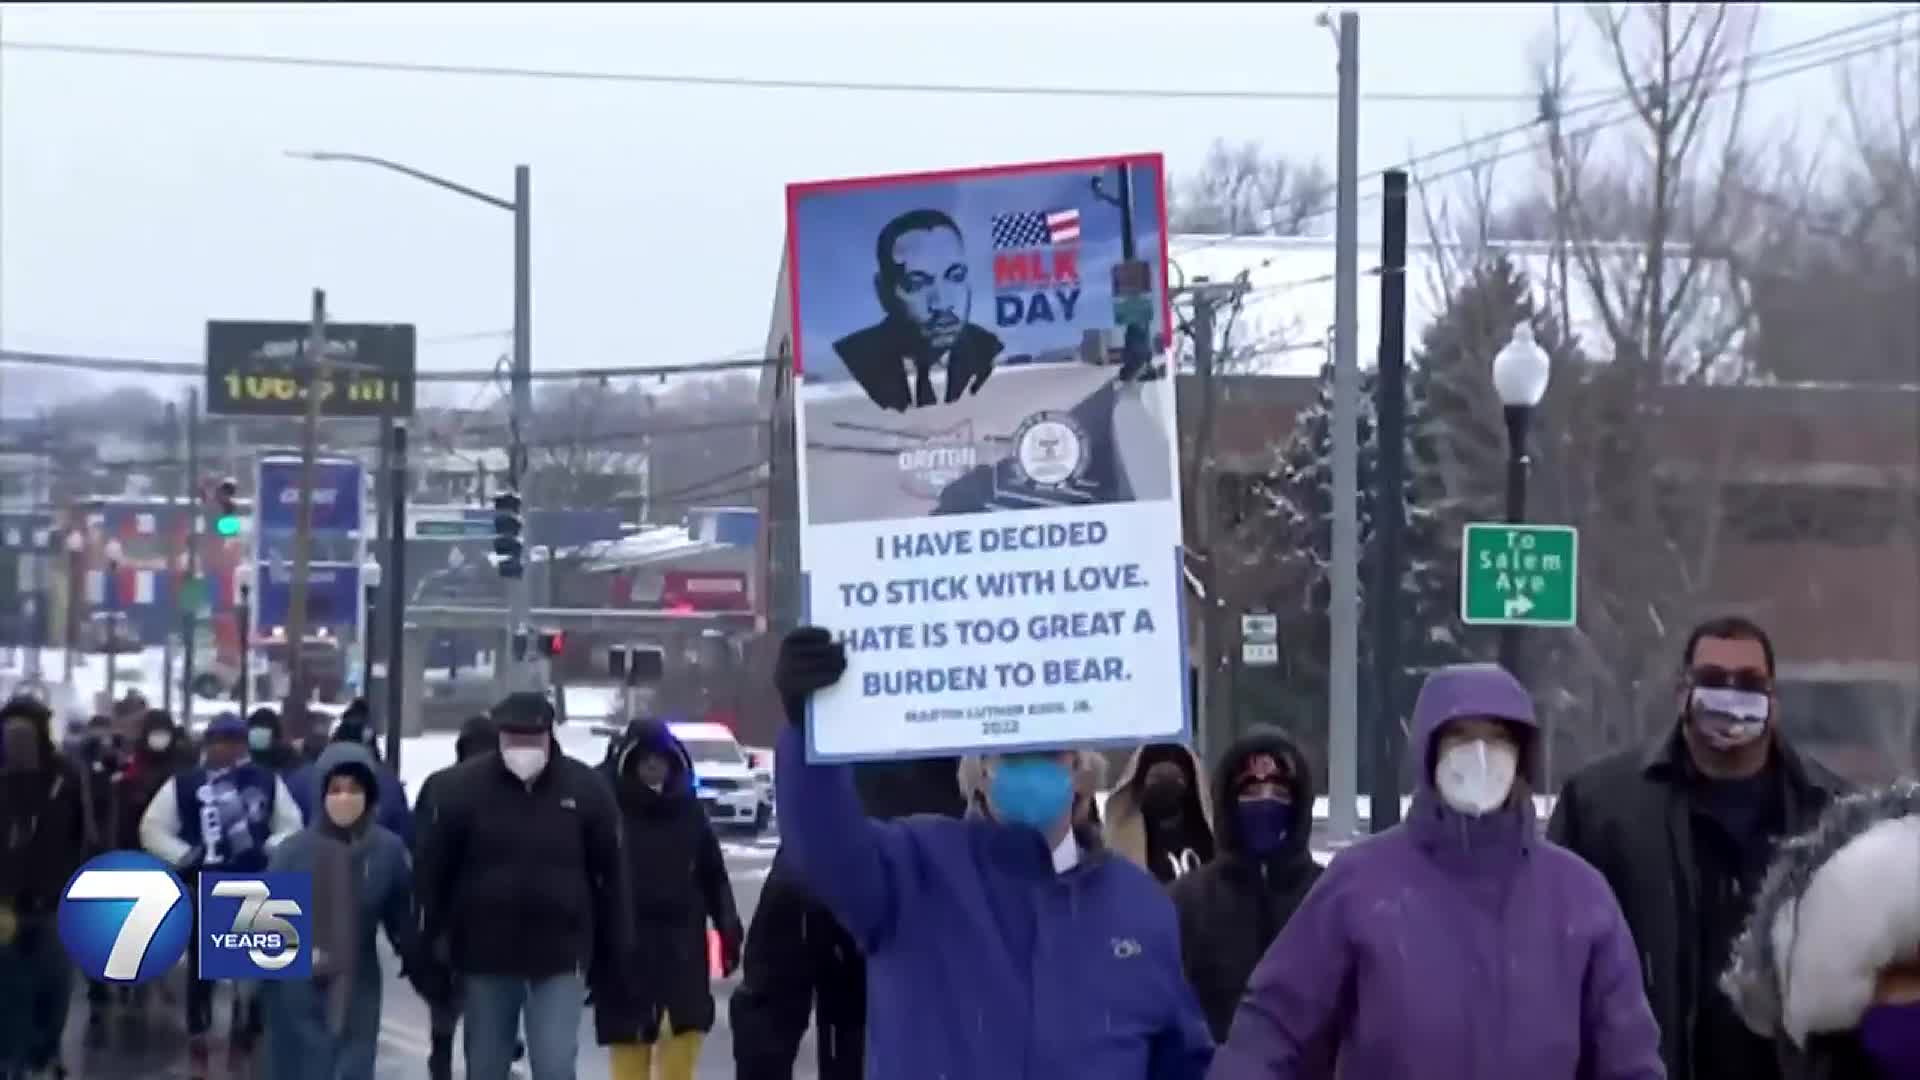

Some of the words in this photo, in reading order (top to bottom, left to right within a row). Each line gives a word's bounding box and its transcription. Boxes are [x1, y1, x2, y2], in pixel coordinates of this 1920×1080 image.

[994, 250, 1079, 285] MLK
[995, 288, 1080, 327] DAY
[876, 537, 884, 560] I
[892, 530, 972, 559] HAVE
[980, 521, 1108, 553] DECIDED
[1506, 531, 1535, 549] To
[1479, 549, 1561, 571] Salem
[839, 582, 878, 607] TO
[887, 575, 969, 603] STICK
[976, 570, 1054, 598] WITH
[1064, 564, 1149, 592] LOVE.
[1496, 572, 1545, 592] Ave
[839, 626, 915, 652] HATE
[923, 624, 947, 648] IS
[955, 618, 1019, 645] TOO
[1028, 610, 1127, 640] GREAT
[1133, 608, 1155, 633] A
[862, 665, 987, 697] BURDEN
[994, 661, 1035, 688] TO
[1043, 656, 1132, 685] BEAR.
